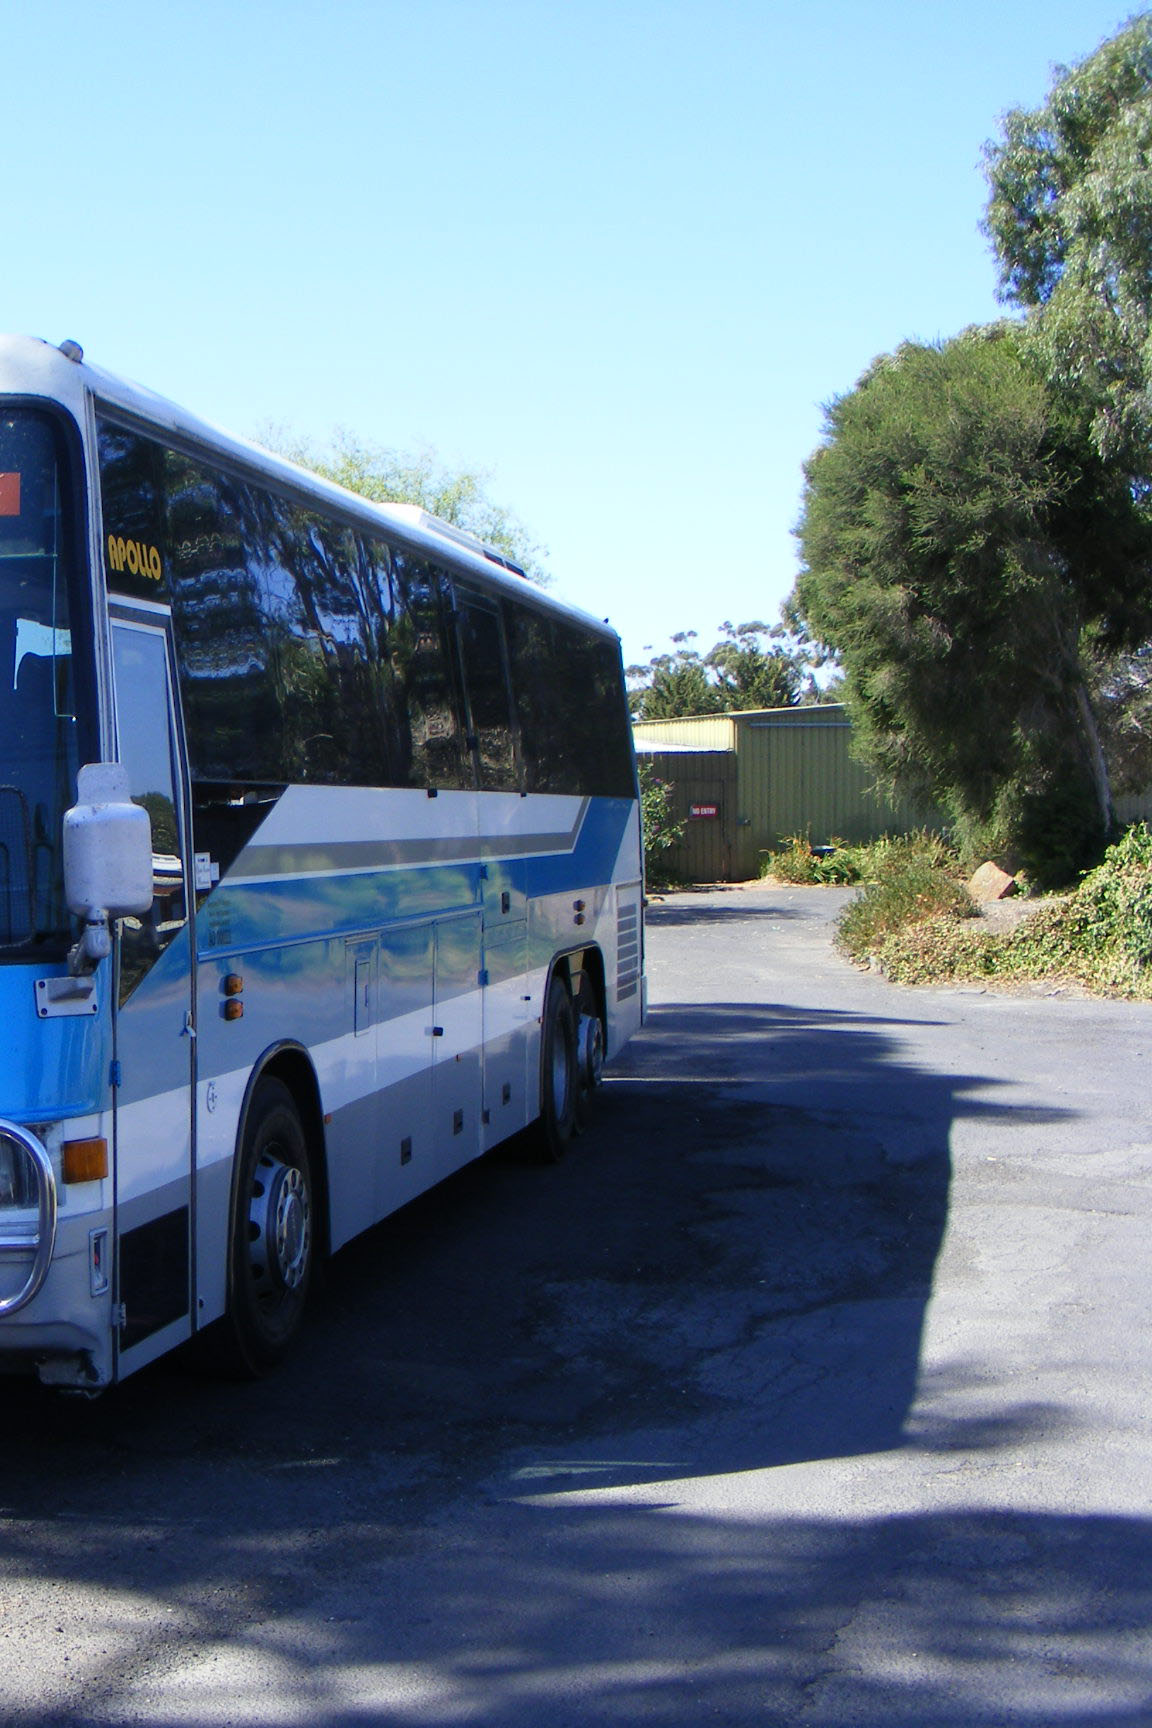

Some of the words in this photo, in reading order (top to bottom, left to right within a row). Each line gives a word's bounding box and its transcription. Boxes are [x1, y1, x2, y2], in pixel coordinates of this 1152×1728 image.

[108, 535, 162, 580] APOLLO
[692, 807, 700, 815] NO
[701, 807, 716, 815] ENTRY
